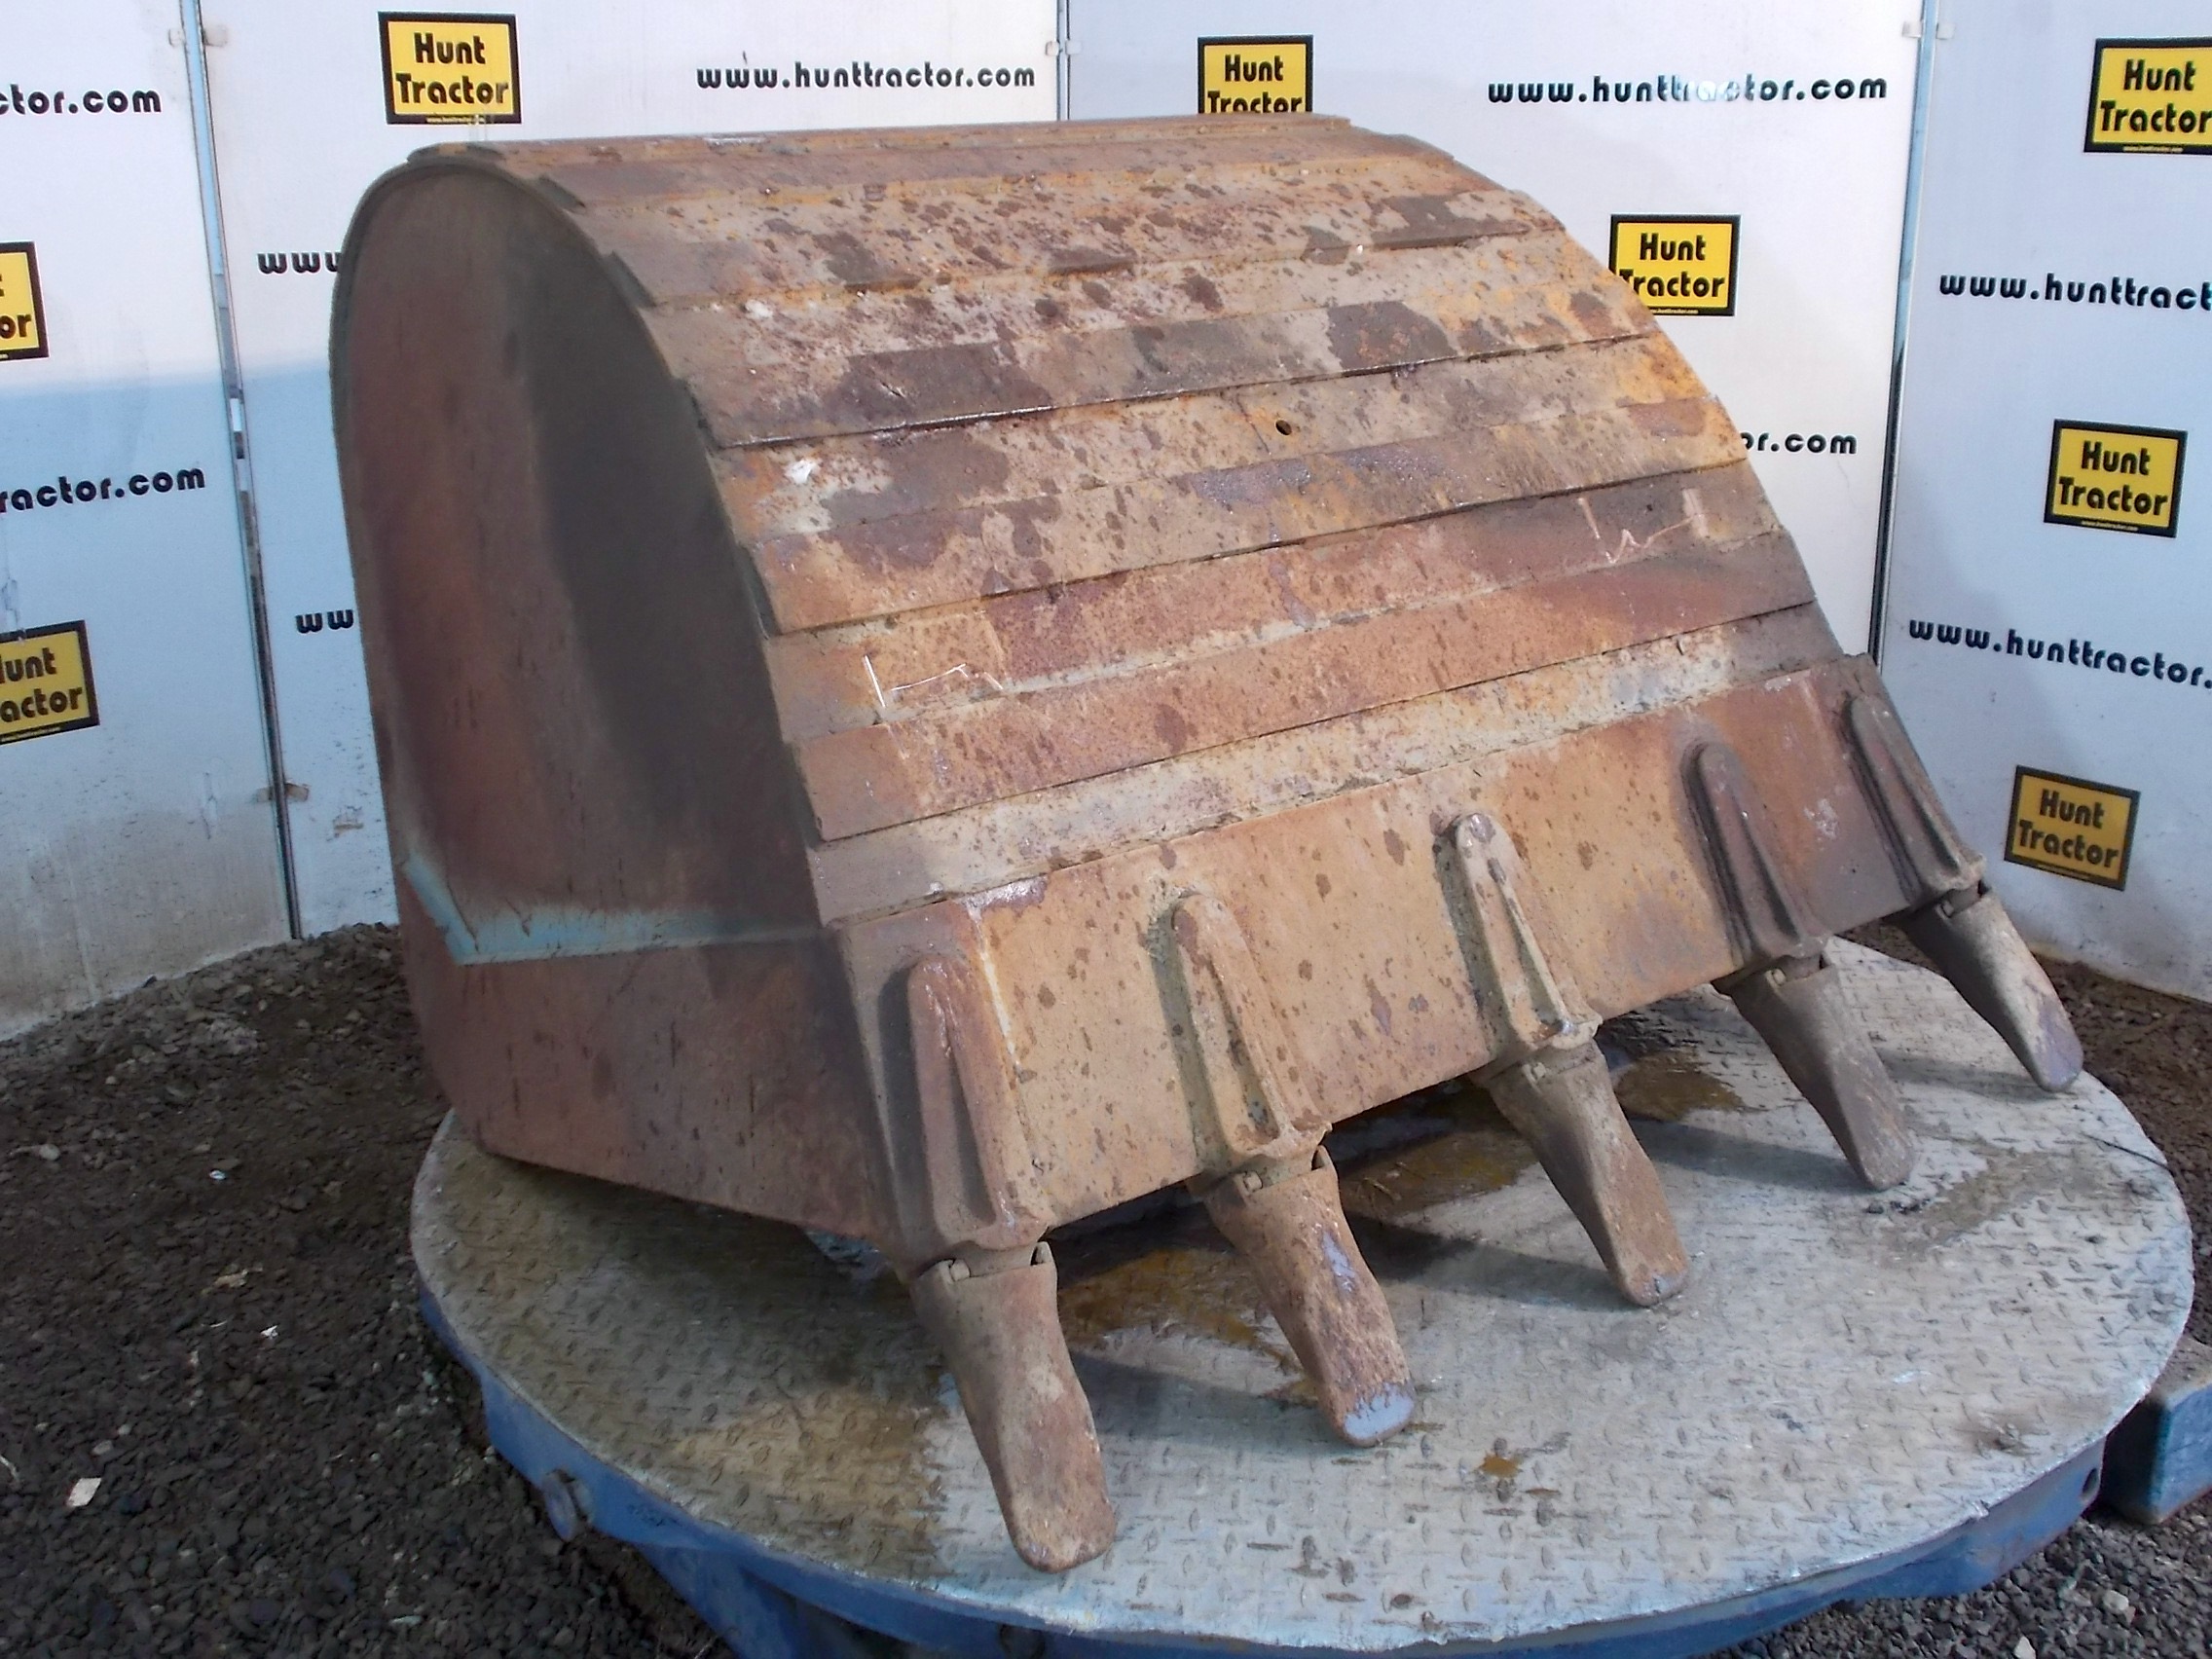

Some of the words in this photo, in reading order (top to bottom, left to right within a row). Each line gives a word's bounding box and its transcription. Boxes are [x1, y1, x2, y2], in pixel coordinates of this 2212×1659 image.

[414, 32, 486, 64] Hunt
[697, 61, 1035, 89] www.hunttractor.com
[1225, 55, 1283, 82] Hunt
[2123, 59, 2196, 91] Hunt
[395, 73, 509, 104] Tractor
[1208, 91, 1302, 113] Tractor
[2100, 100, 2212, 133] Tractor
[1640, 233, 1706, 261] Hunt
[1939, 273, 2212, 312] www.hunttract
[2081, 440, 2151, 476] Hunt
[2059, 476, 2168, 516] Tractor
[0, 687, 82, 722] actor
[2040, 789, 2105, 830] Hunt
[2019, 819, 2119, 868] Tractor
